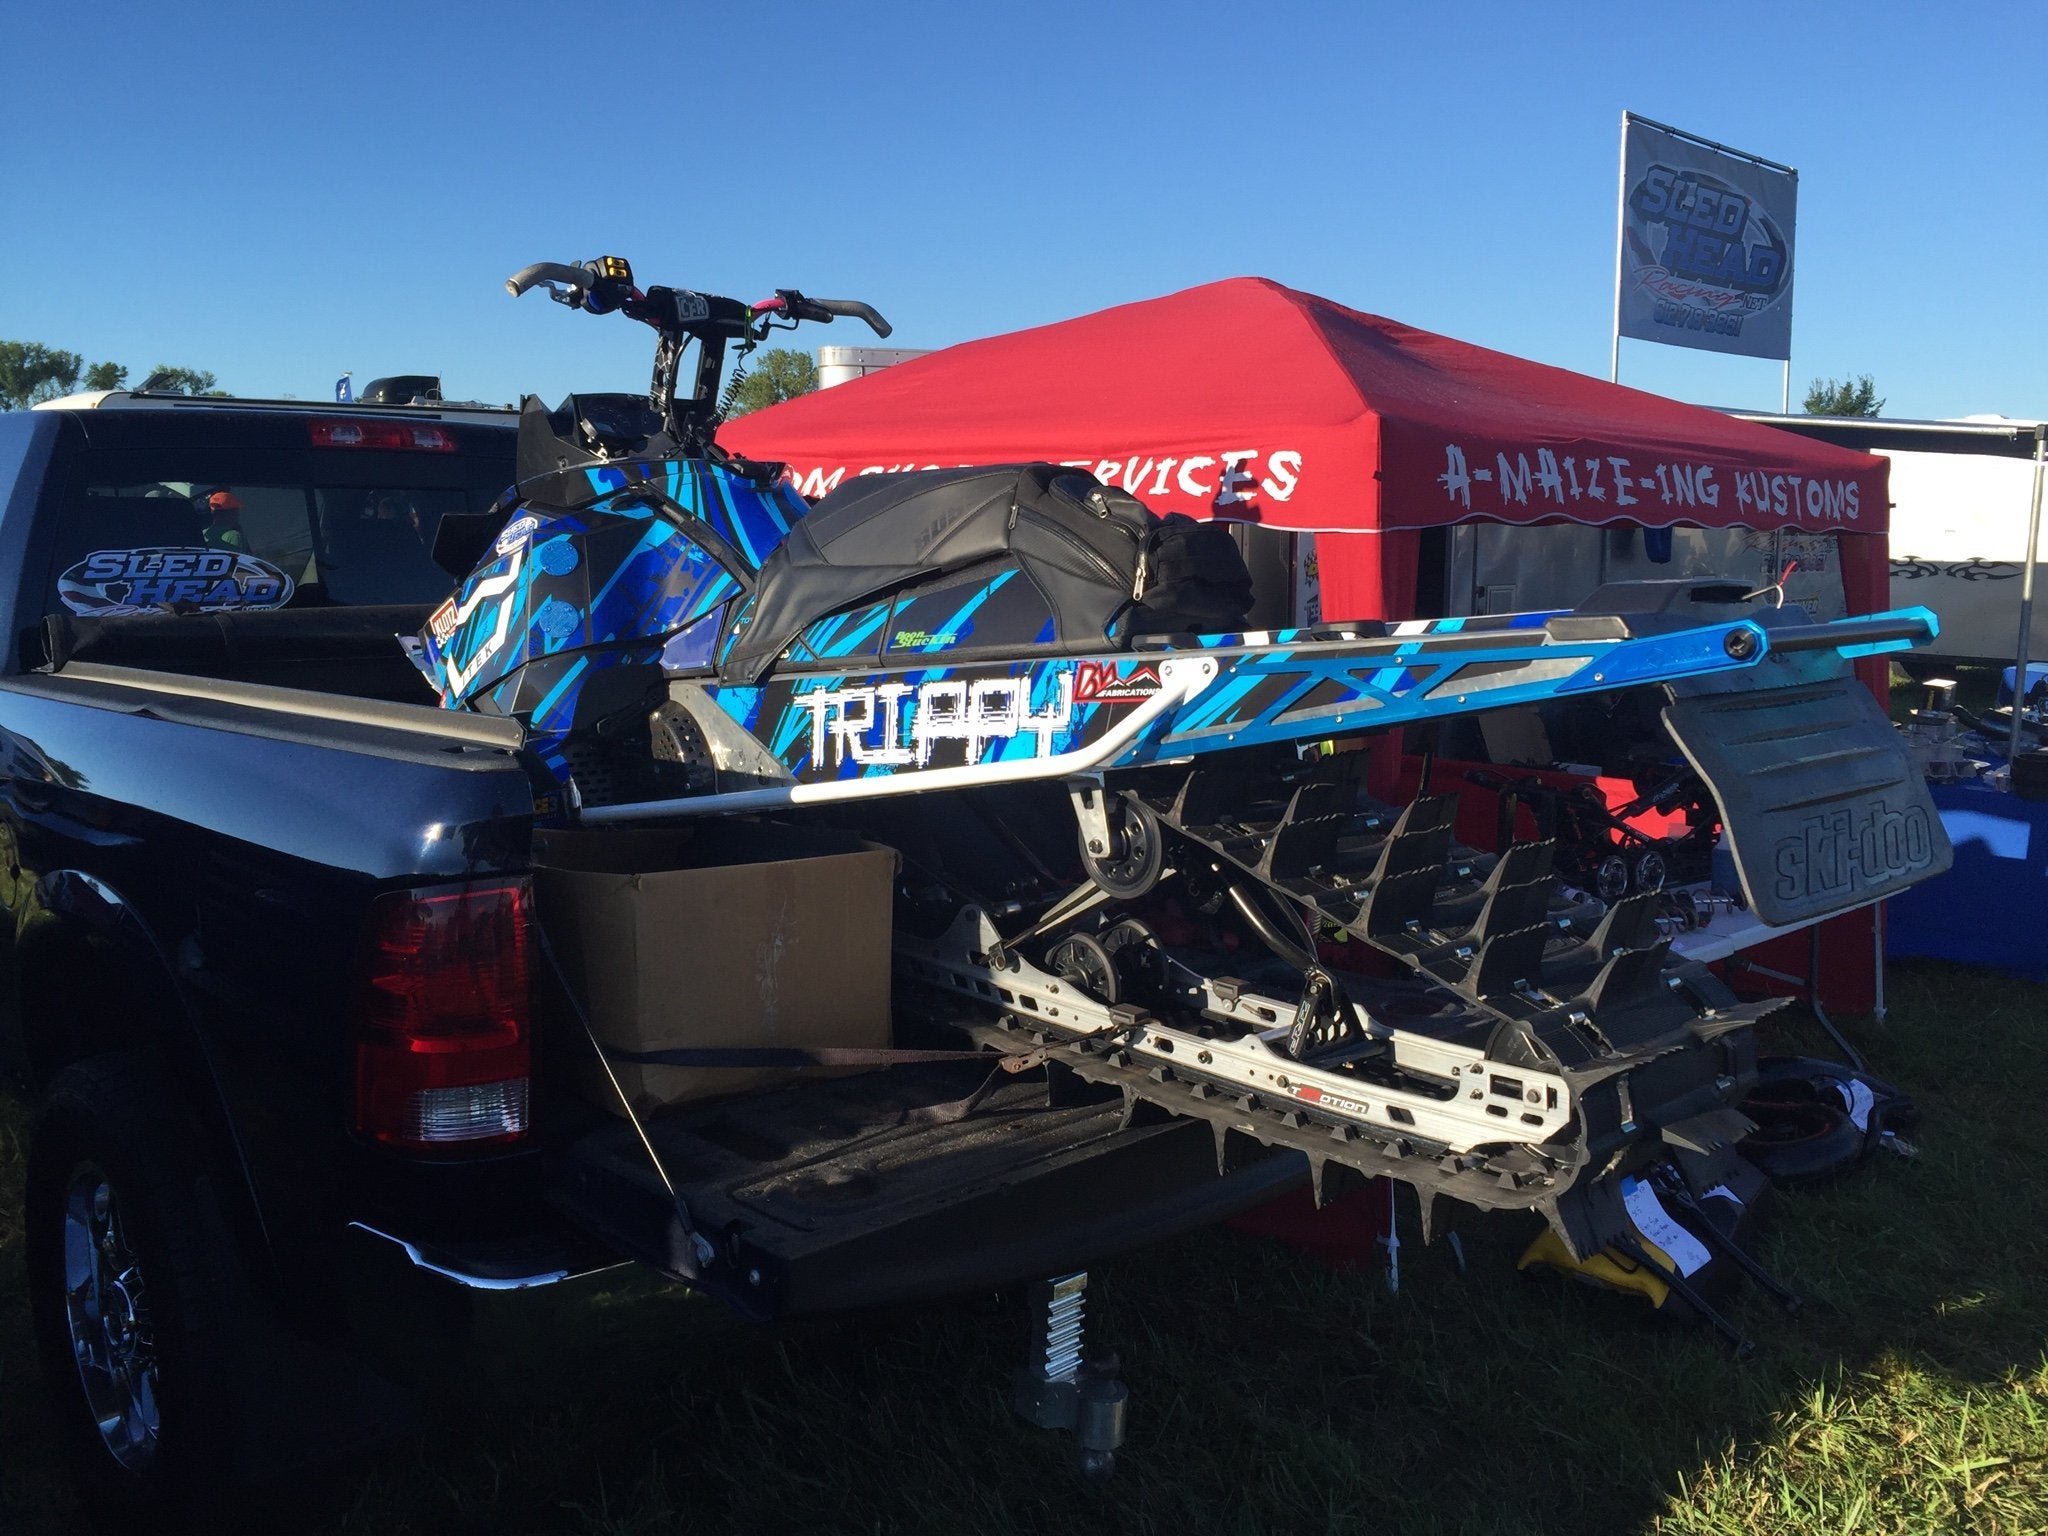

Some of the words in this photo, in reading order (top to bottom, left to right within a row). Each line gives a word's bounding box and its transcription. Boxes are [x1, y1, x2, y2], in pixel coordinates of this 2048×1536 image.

[1641, 165, 1746, 236] SLED
[1660, 221, 1781, 287] HEAD
[1438, 443, 1720, 510] A-MAIZE-ING
[1735, 470, 1860, 521] KUSTOMS
[83, 552, 235, 580] SLED
[123, 579, 281, 605] HEAD
[794, 670, 1074, 770] TRIPPY
[1102, 688, 1159, 698] FABRICATIONS
